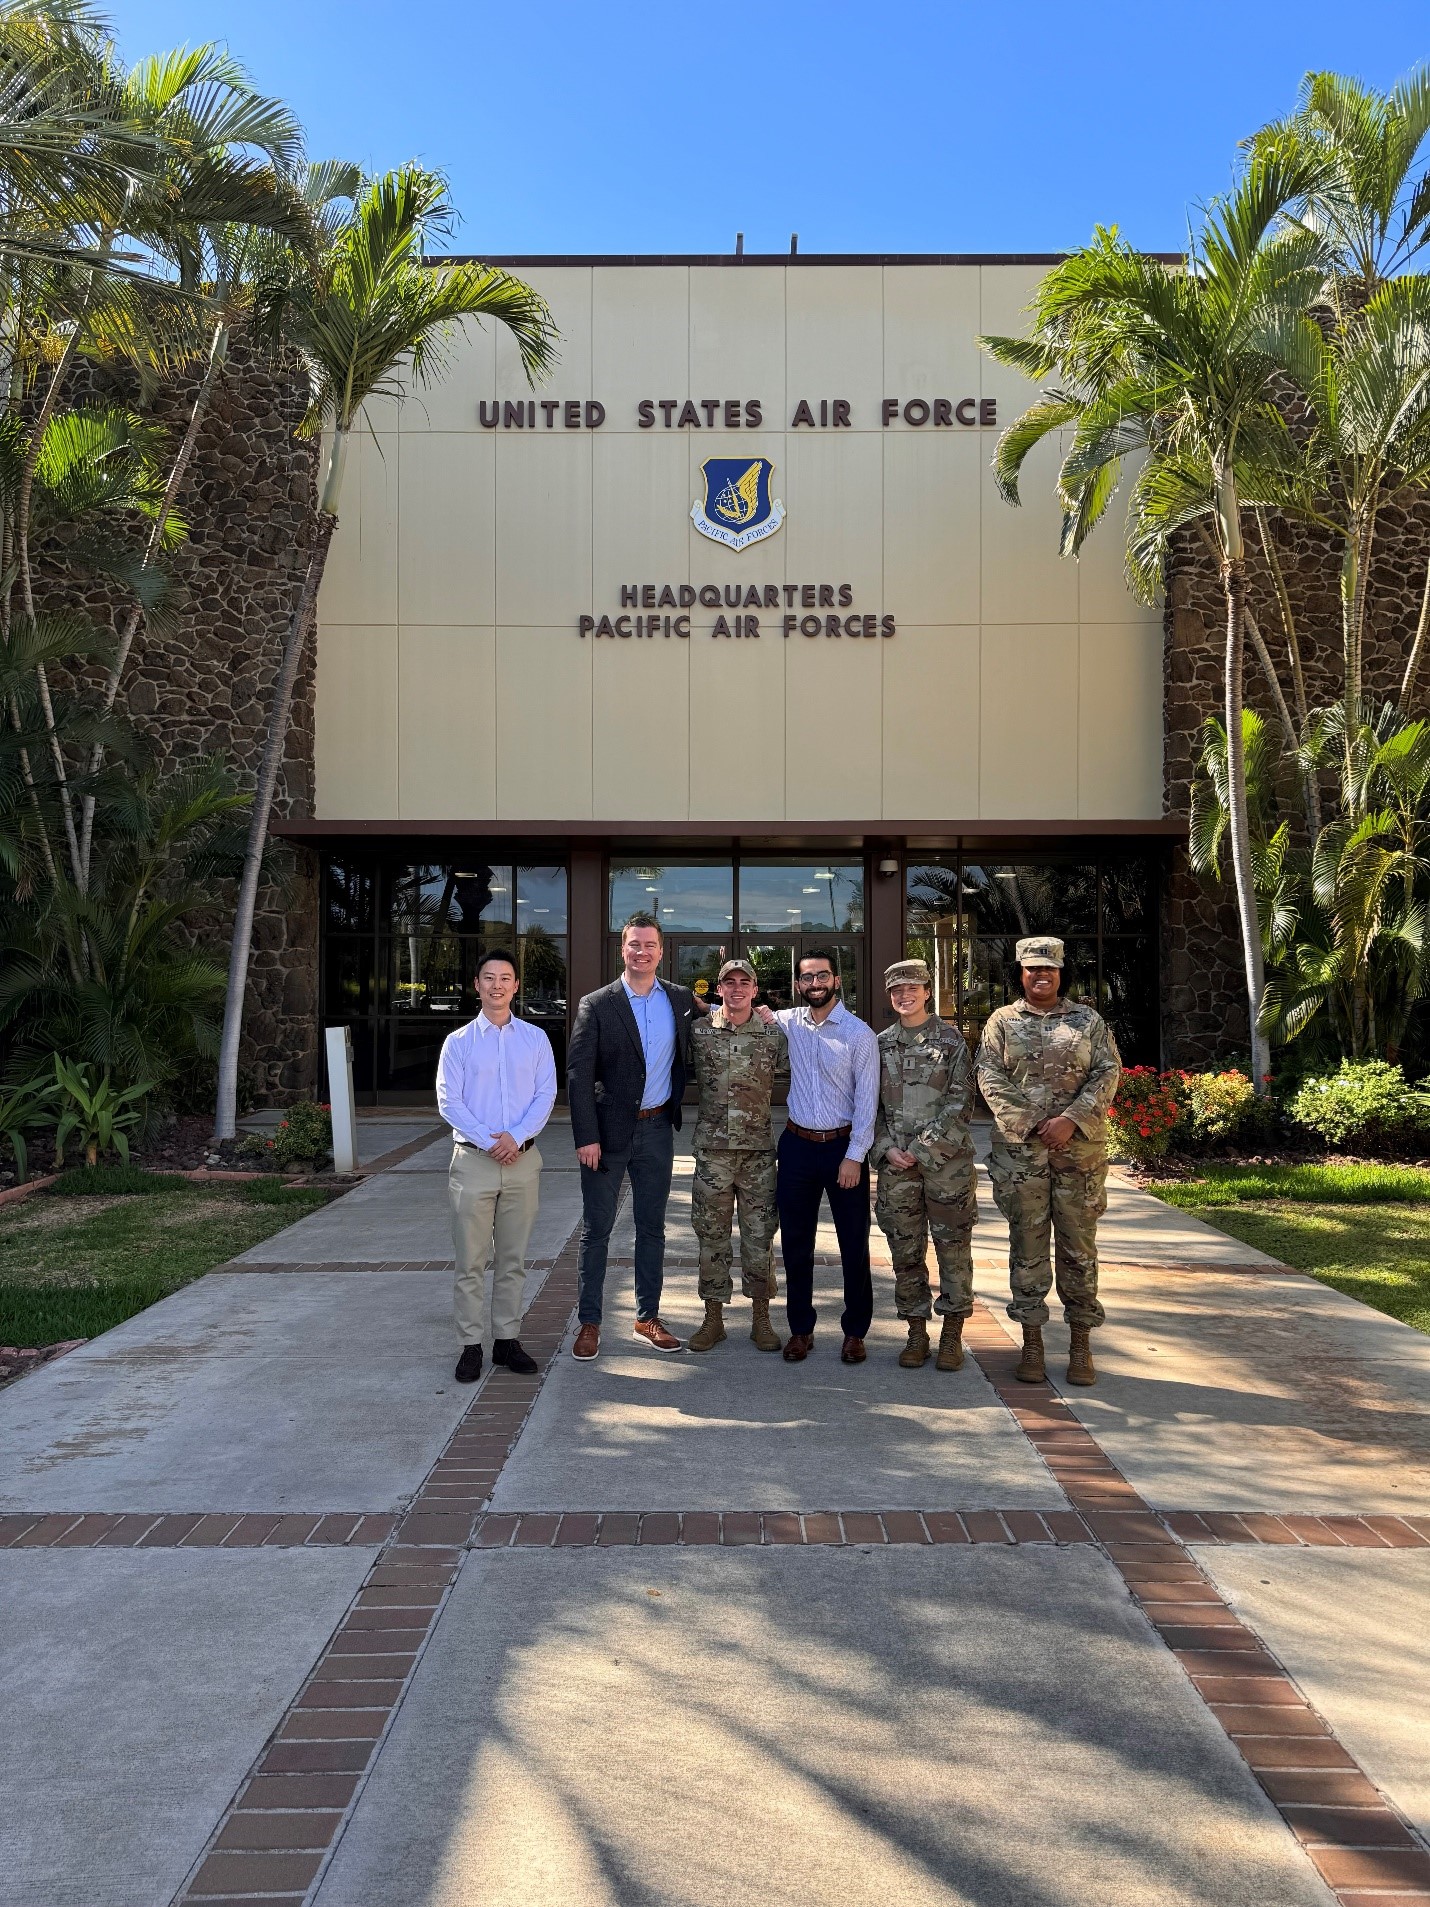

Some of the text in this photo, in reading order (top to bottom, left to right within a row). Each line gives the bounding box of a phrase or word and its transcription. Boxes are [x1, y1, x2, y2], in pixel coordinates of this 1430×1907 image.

[479, 398, 997, 428] UNITED STATES AIR FORCE
[698, 519, 778, 547] PACIFIC AIR FORCES
[620, 584, 853, 608] HEADQUARTERS
[579, 614, 896, 638] PACIFIC AIR FORCES
